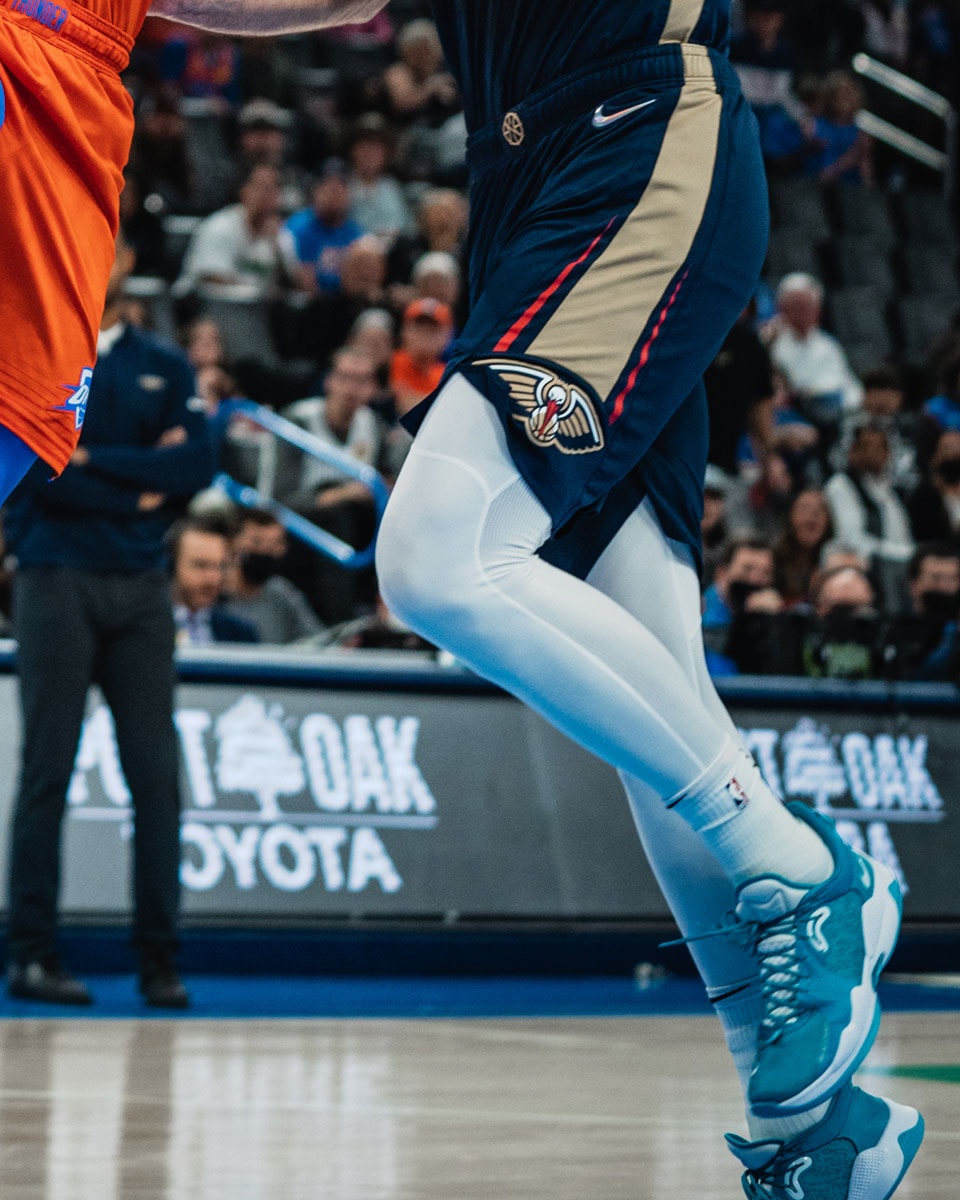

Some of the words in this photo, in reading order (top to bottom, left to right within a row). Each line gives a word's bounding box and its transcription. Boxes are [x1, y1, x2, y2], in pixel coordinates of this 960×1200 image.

[300, 712, 437, 814] OAK
[843, 731, 944, 810] OAK
[121, 821, 403, 893] OYOTA
